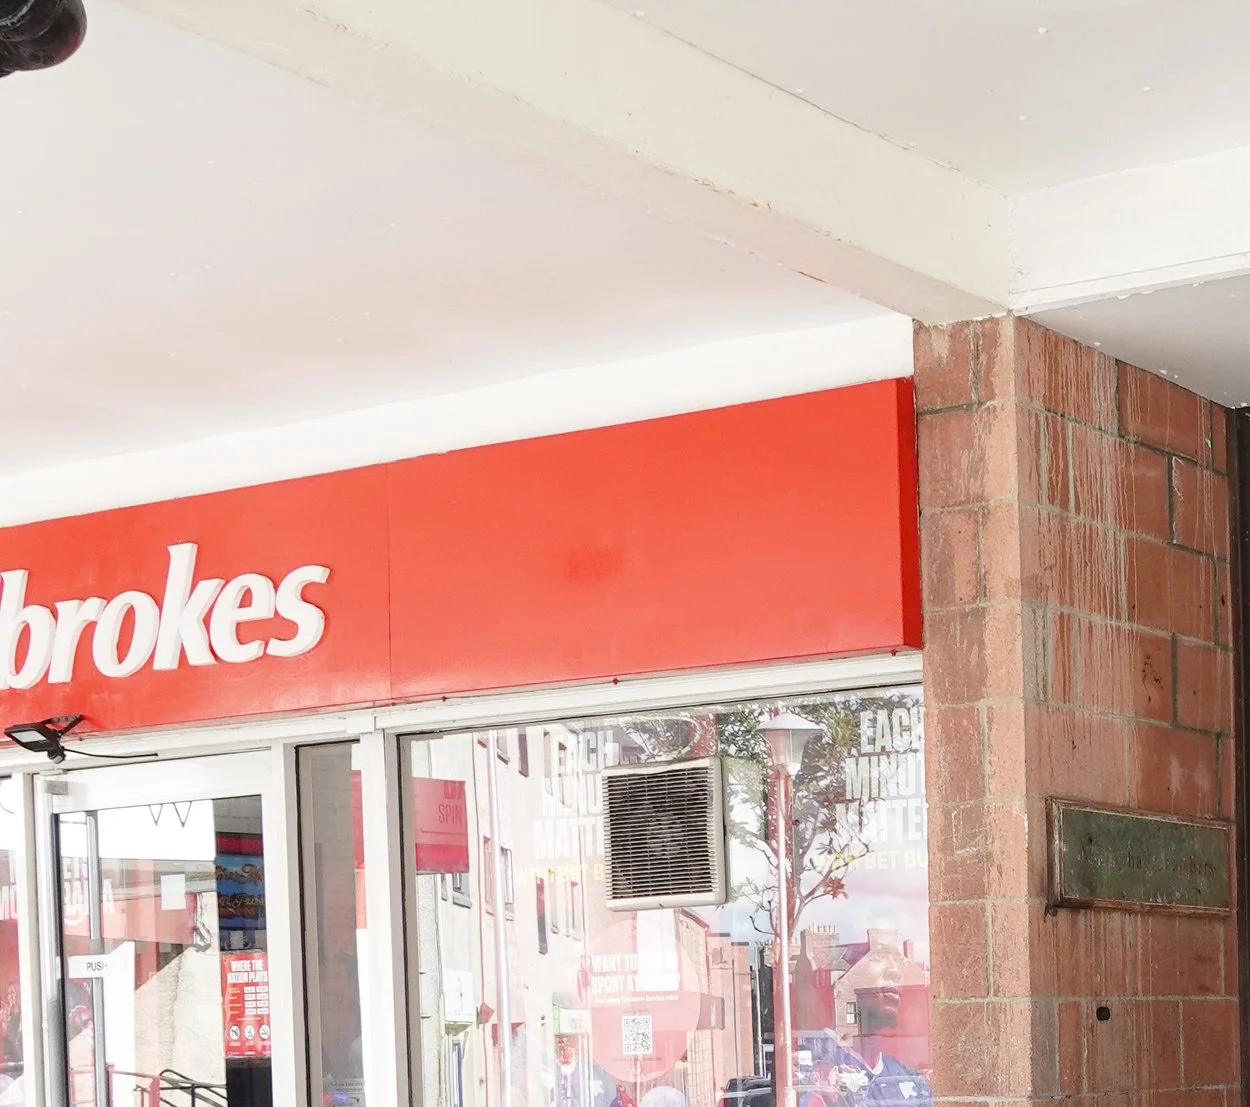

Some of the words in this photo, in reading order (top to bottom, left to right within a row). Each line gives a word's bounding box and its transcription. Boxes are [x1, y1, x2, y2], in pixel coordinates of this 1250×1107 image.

[0, 542, 330, 690] brokes
[438, 804, 463, 824] SPIN
[533, 818, 605, 859] MATT
[86, 962, 108, 971] PUSH
